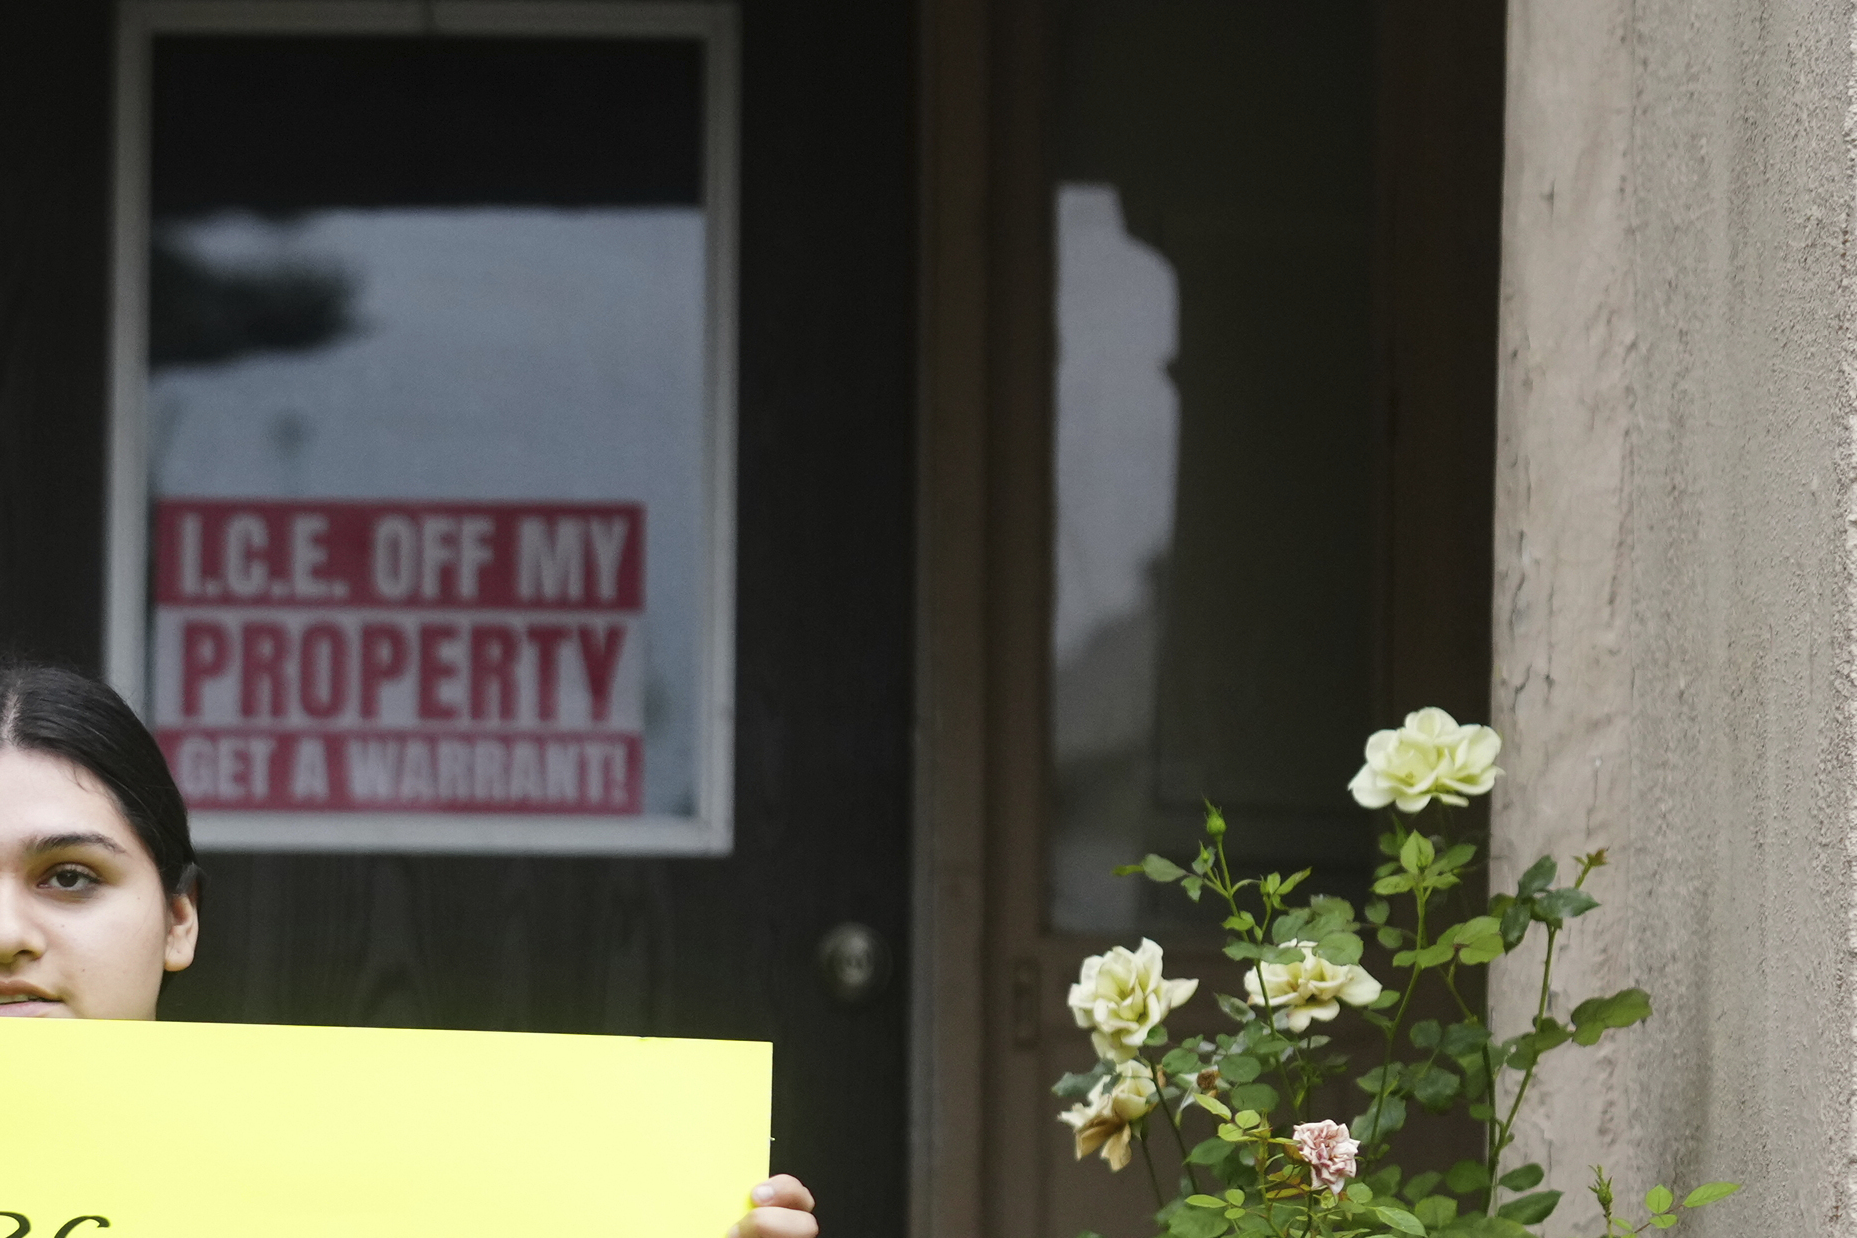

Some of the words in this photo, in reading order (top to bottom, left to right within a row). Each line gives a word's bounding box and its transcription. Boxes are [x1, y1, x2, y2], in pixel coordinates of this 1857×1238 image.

[180, 513, 349, 598] I.C.E.
[373, 516, 496, 600] OFF
[517, 518, 629, 600] MY
[182, 621, 627, 722] PROPERTY
[178, 738, 278, 800] GET
[289, 738, 333, 801] A
[347, 740, 628, 804] WARRANT!
